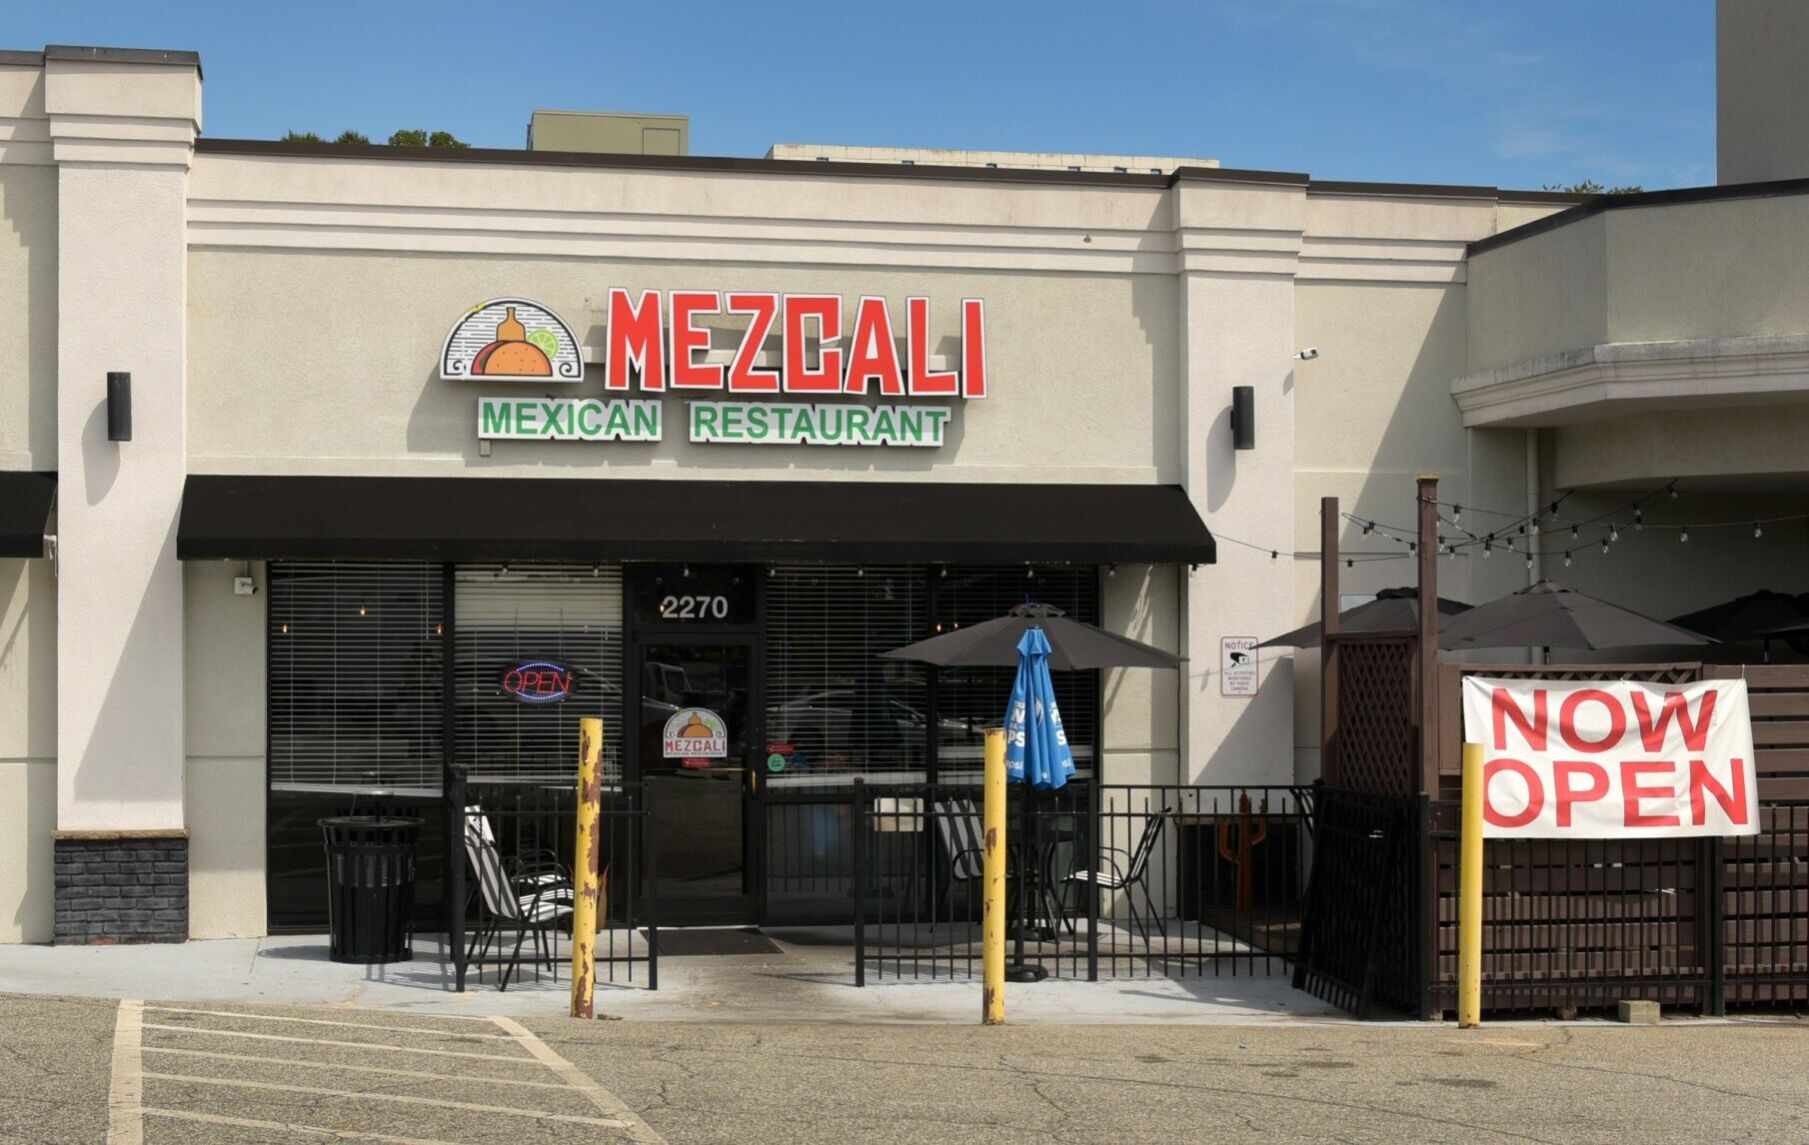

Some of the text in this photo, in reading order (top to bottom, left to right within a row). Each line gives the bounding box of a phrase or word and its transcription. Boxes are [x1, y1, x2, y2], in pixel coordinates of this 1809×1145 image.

[605, 288, 986, 398] MEZCALI
[482, 402, 946, 442] MEXICAN RESTAURANT
[662, 596, 728, 618] 2270
[504, 671, 573, 694] OPEN
[1492, 688, 1718, 753] NOW
[665, 740, 726, 752] MEZCALI
[1483, 758, 1748, 828] OPEN
